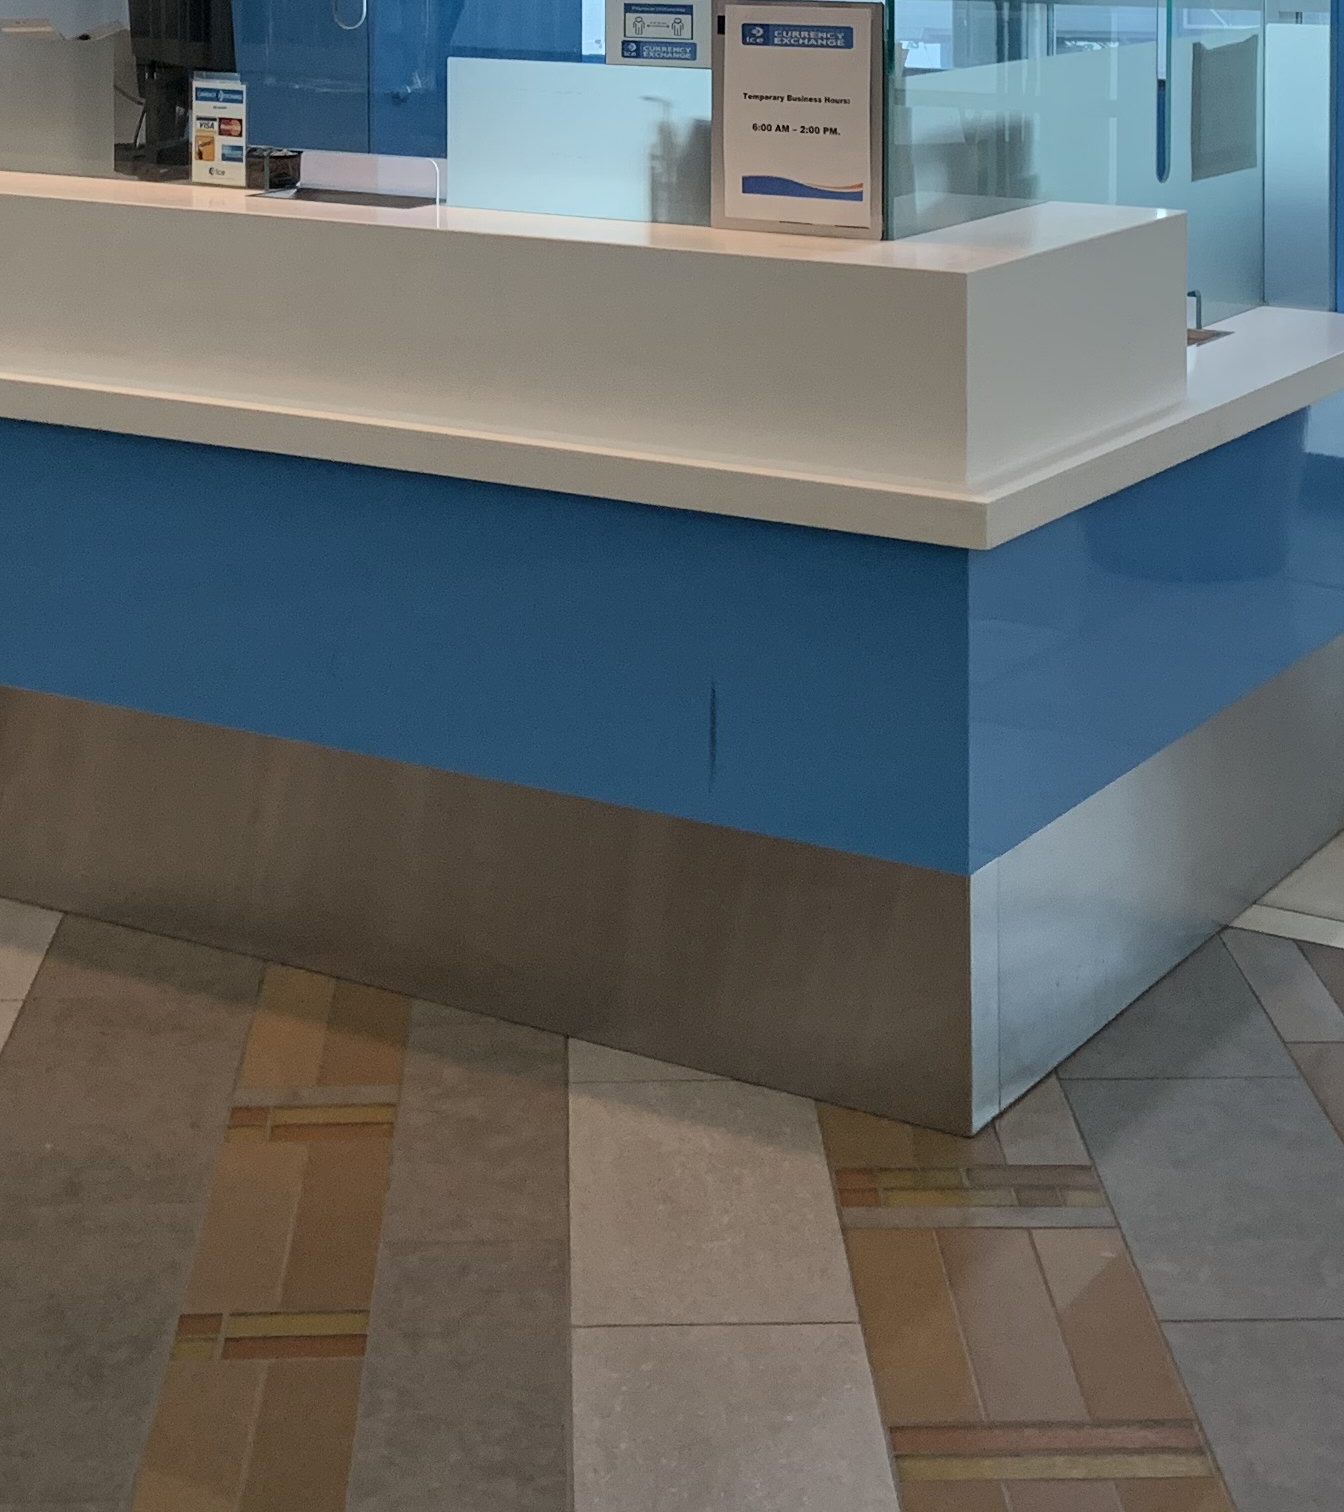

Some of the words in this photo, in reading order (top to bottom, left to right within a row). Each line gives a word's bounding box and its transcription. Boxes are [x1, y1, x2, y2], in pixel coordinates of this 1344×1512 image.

[774, 30, 845, 39] CURRENCY
[774, 38, 845, 47] EXCHANGE
[743, 92, 785, 103] Temporary
[787, 94, 822, 103] Business
[824, 96, 850, 104] Hours:
[199, 122, 215, 130] VISA
[775, 124, 789, 133] AM
[800, 125, 820, 135] 2:00
